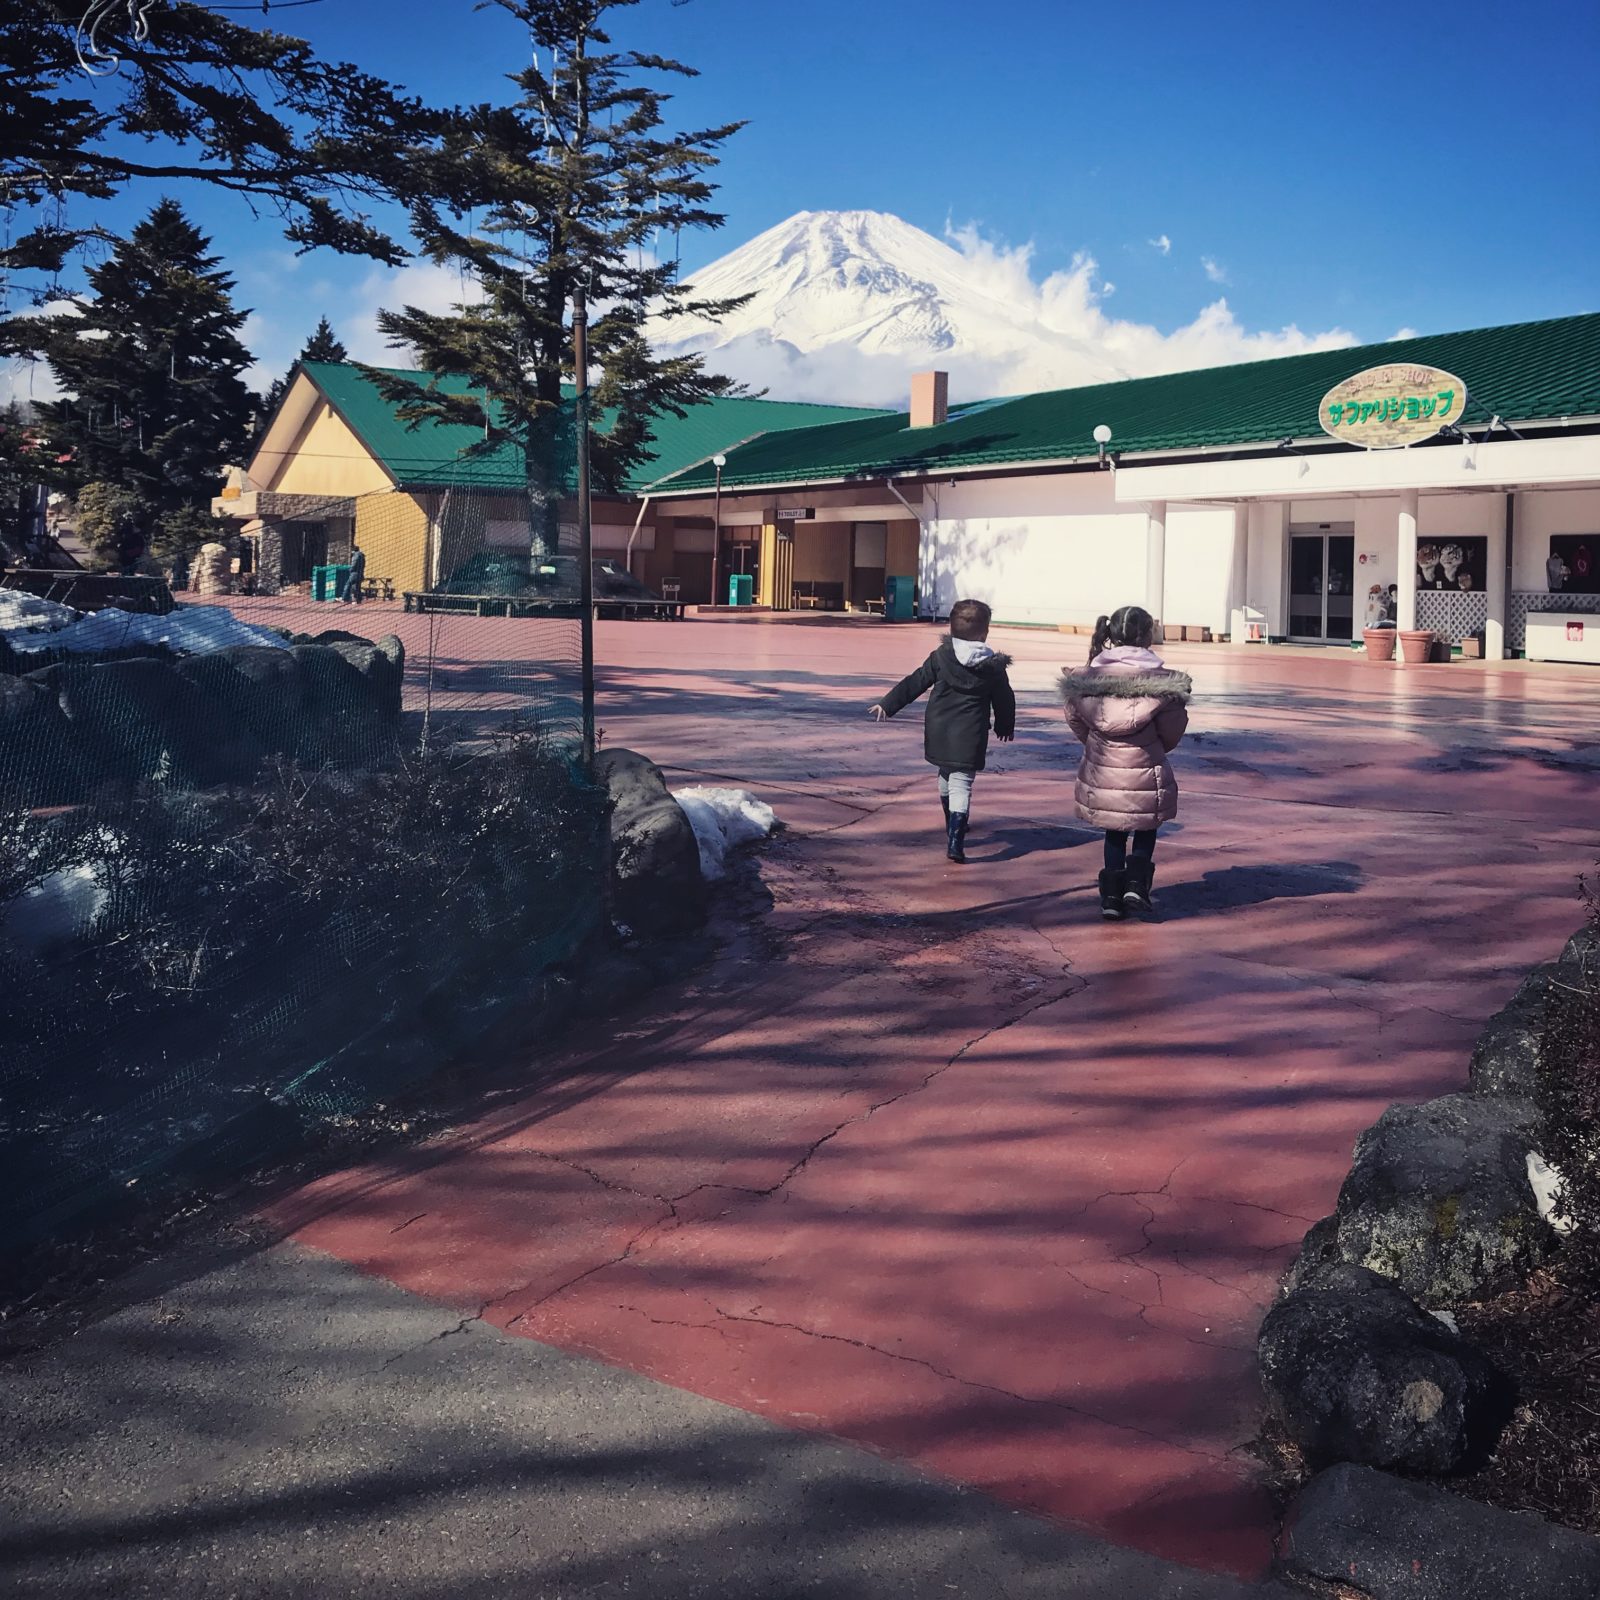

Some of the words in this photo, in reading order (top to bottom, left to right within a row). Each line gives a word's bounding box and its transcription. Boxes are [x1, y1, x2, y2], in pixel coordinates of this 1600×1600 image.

[1400, 369, 1433, 385] SHOP
[1328, 389, 1455, 426] サファリショップ
